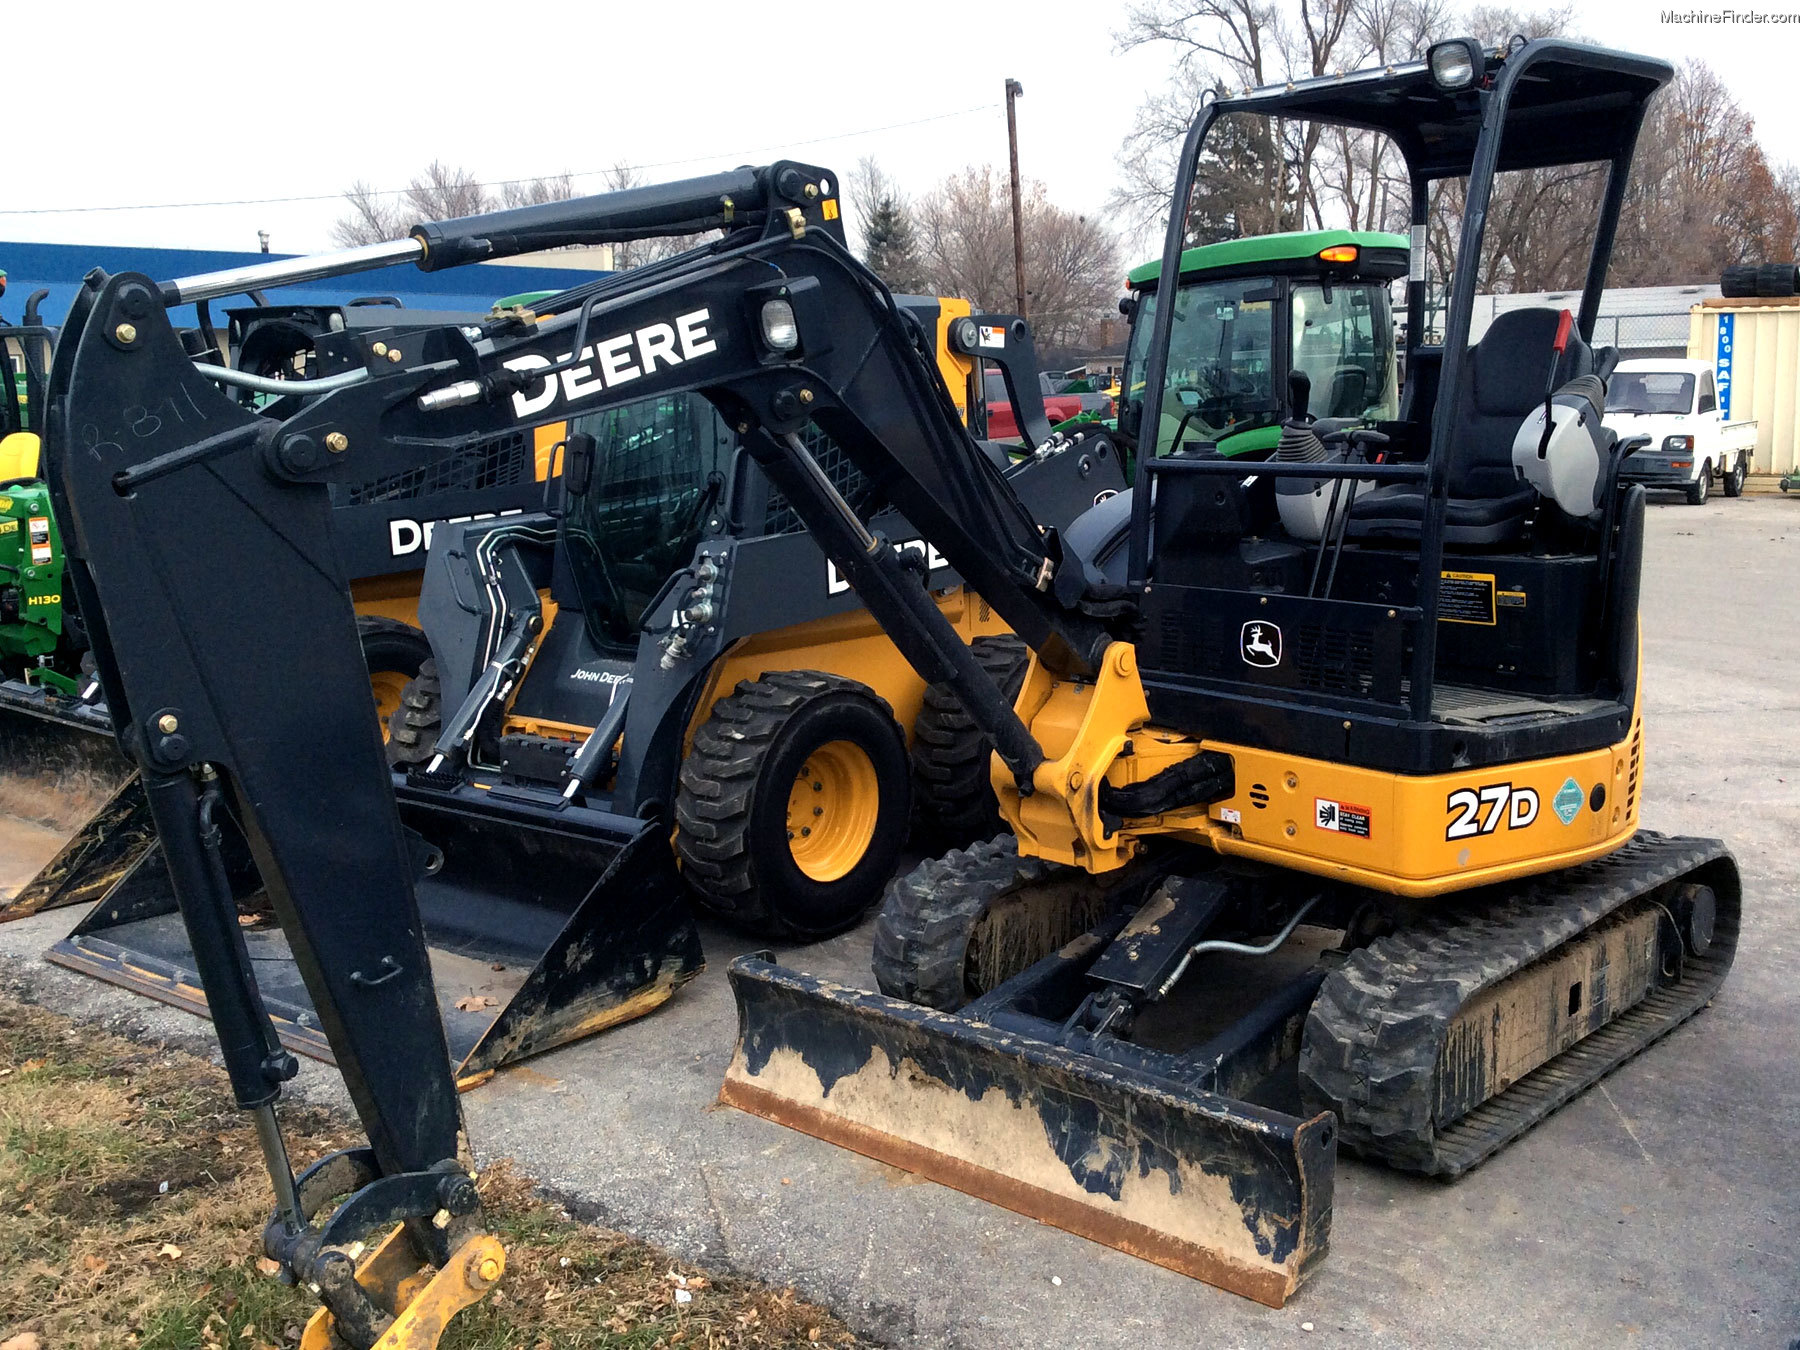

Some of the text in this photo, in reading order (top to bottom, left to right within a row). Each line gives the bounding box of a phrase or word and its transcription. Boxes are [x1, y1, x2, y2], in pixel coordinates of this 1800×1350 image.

[502, 308, 717, 419] DEERE
[28, 595, 61, 606] H130
[570, 668, 600, 681] JOHN
[1445, 782, 1541, 842] 27D
